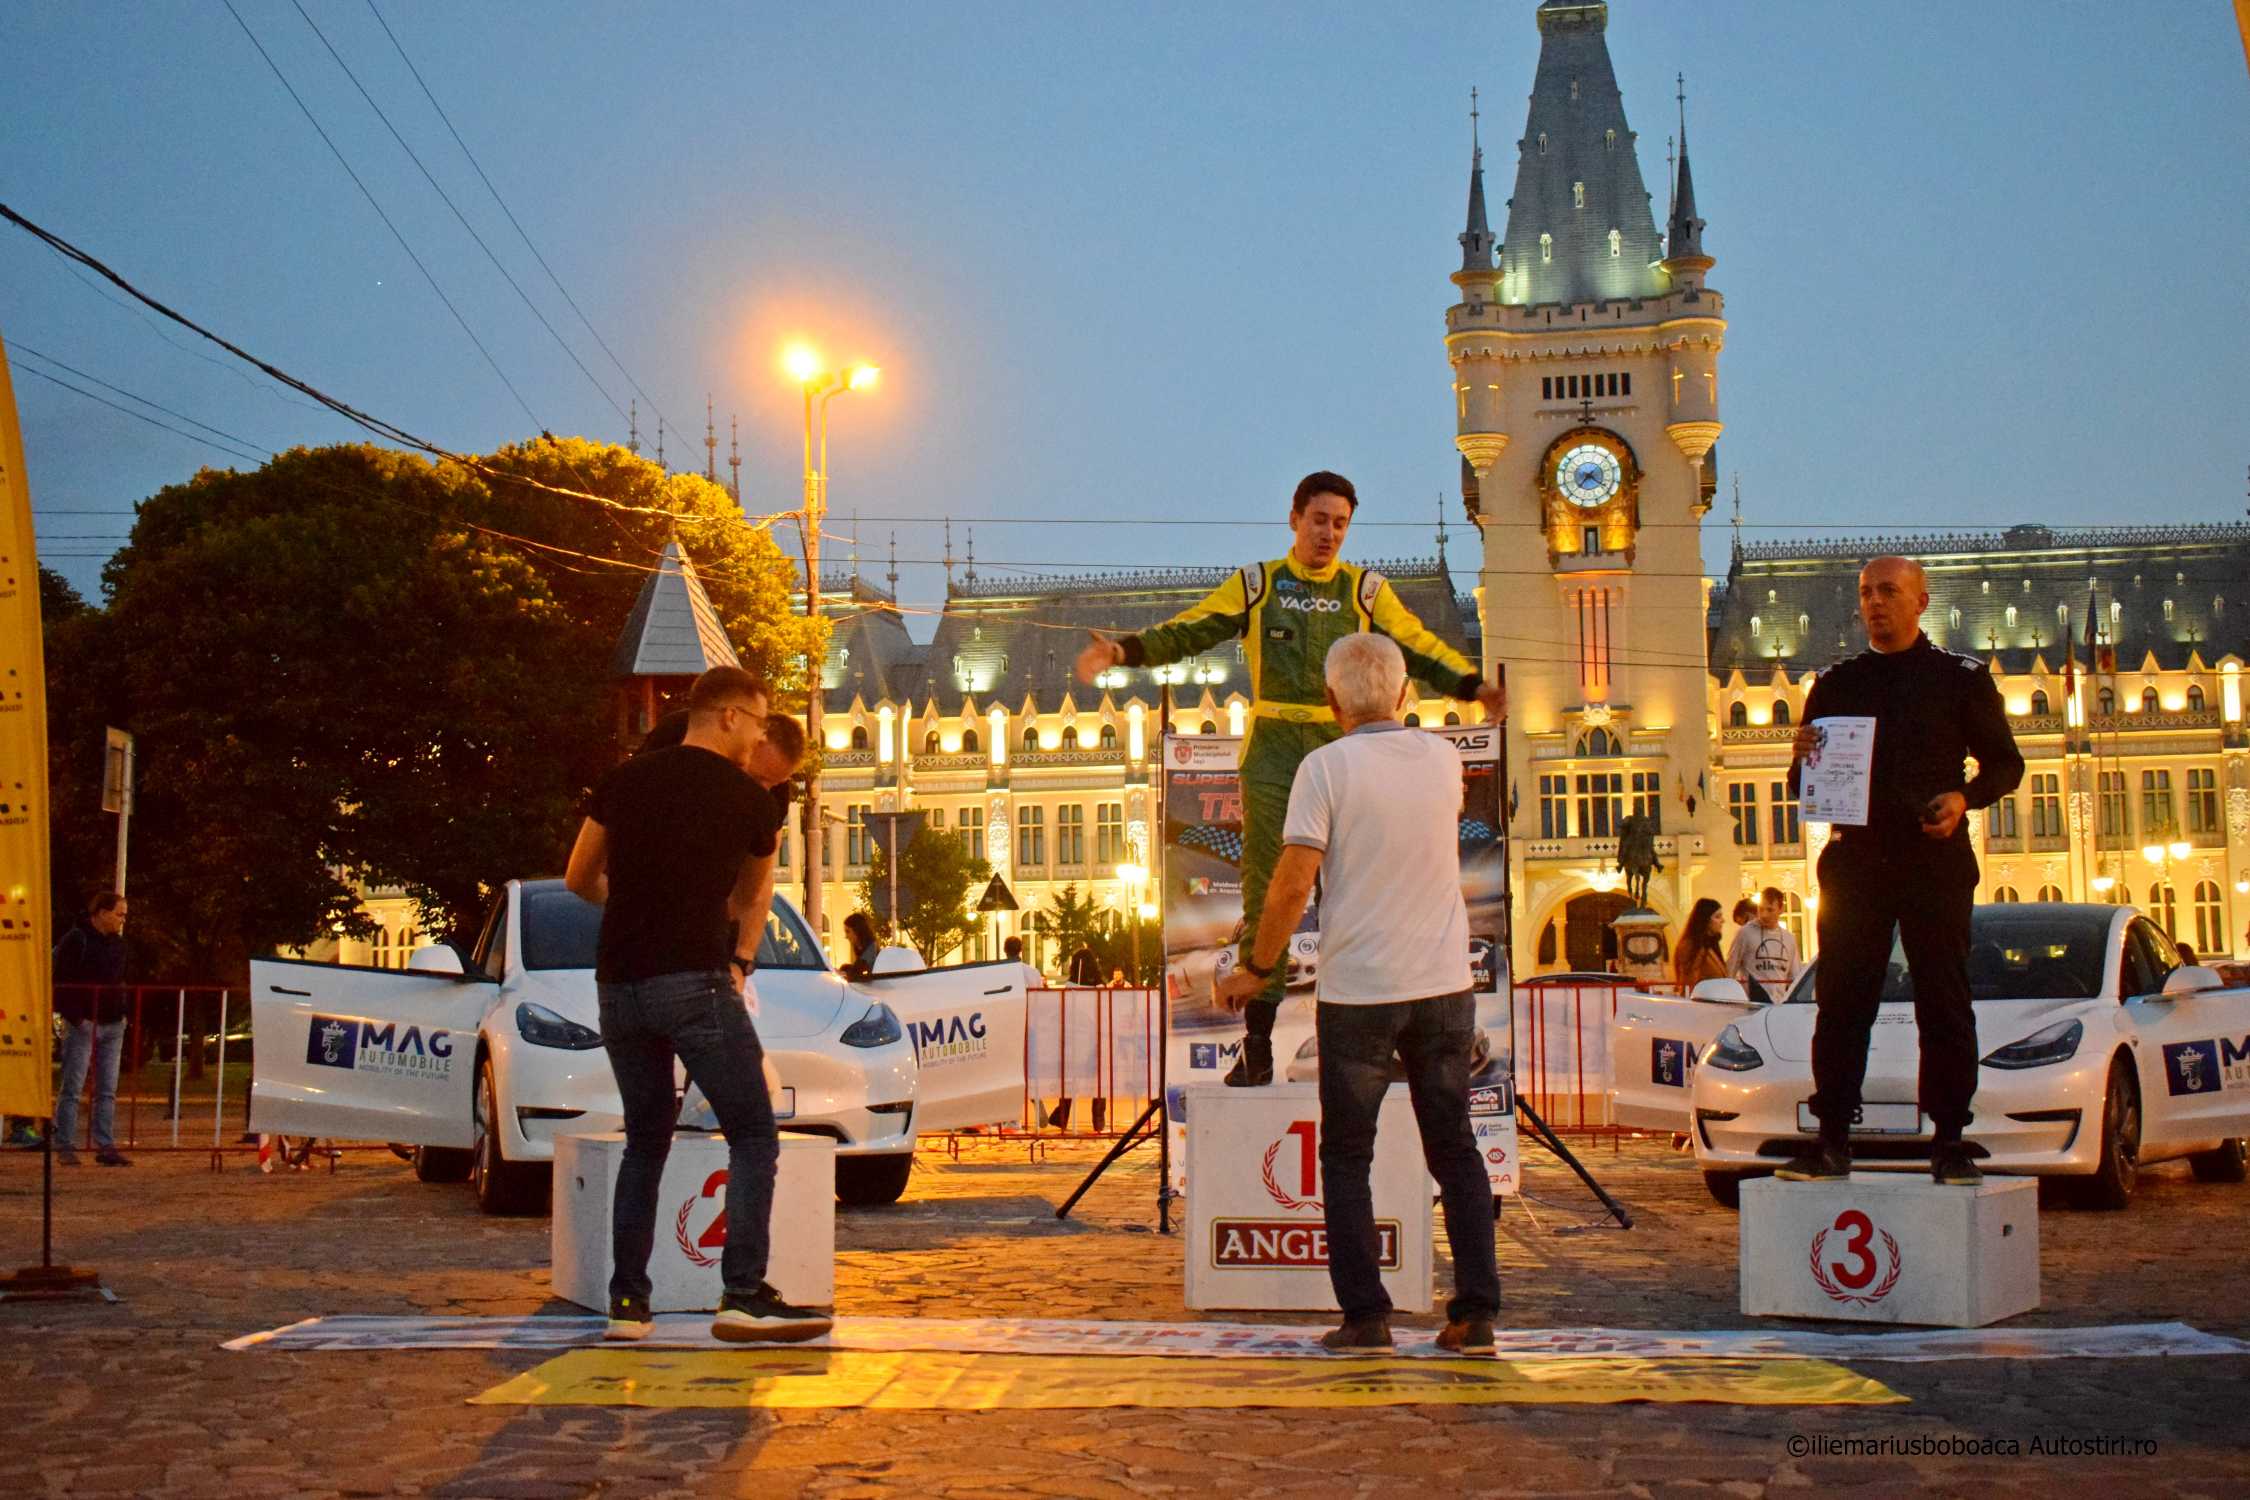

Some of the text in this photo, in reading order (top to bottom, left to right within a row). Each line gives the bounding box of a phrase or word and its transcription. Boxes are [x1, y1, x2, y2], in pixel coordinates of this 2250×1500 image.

[361, 1022, 453, 1058] MAG
[920, 1012, 986, 1049] MAG
[360, 1050, 450, 1072] AUTOMOBILE
[922, 1039, 986, 1062] AUTOMOBILE
[2220, 1035, 2250, 1067] M
[1286, 1121, 1316, 1197] 1
[1219, 1229, 1393, 1261] ANGEI
[1831, 1209, 1877, 1290] 3
